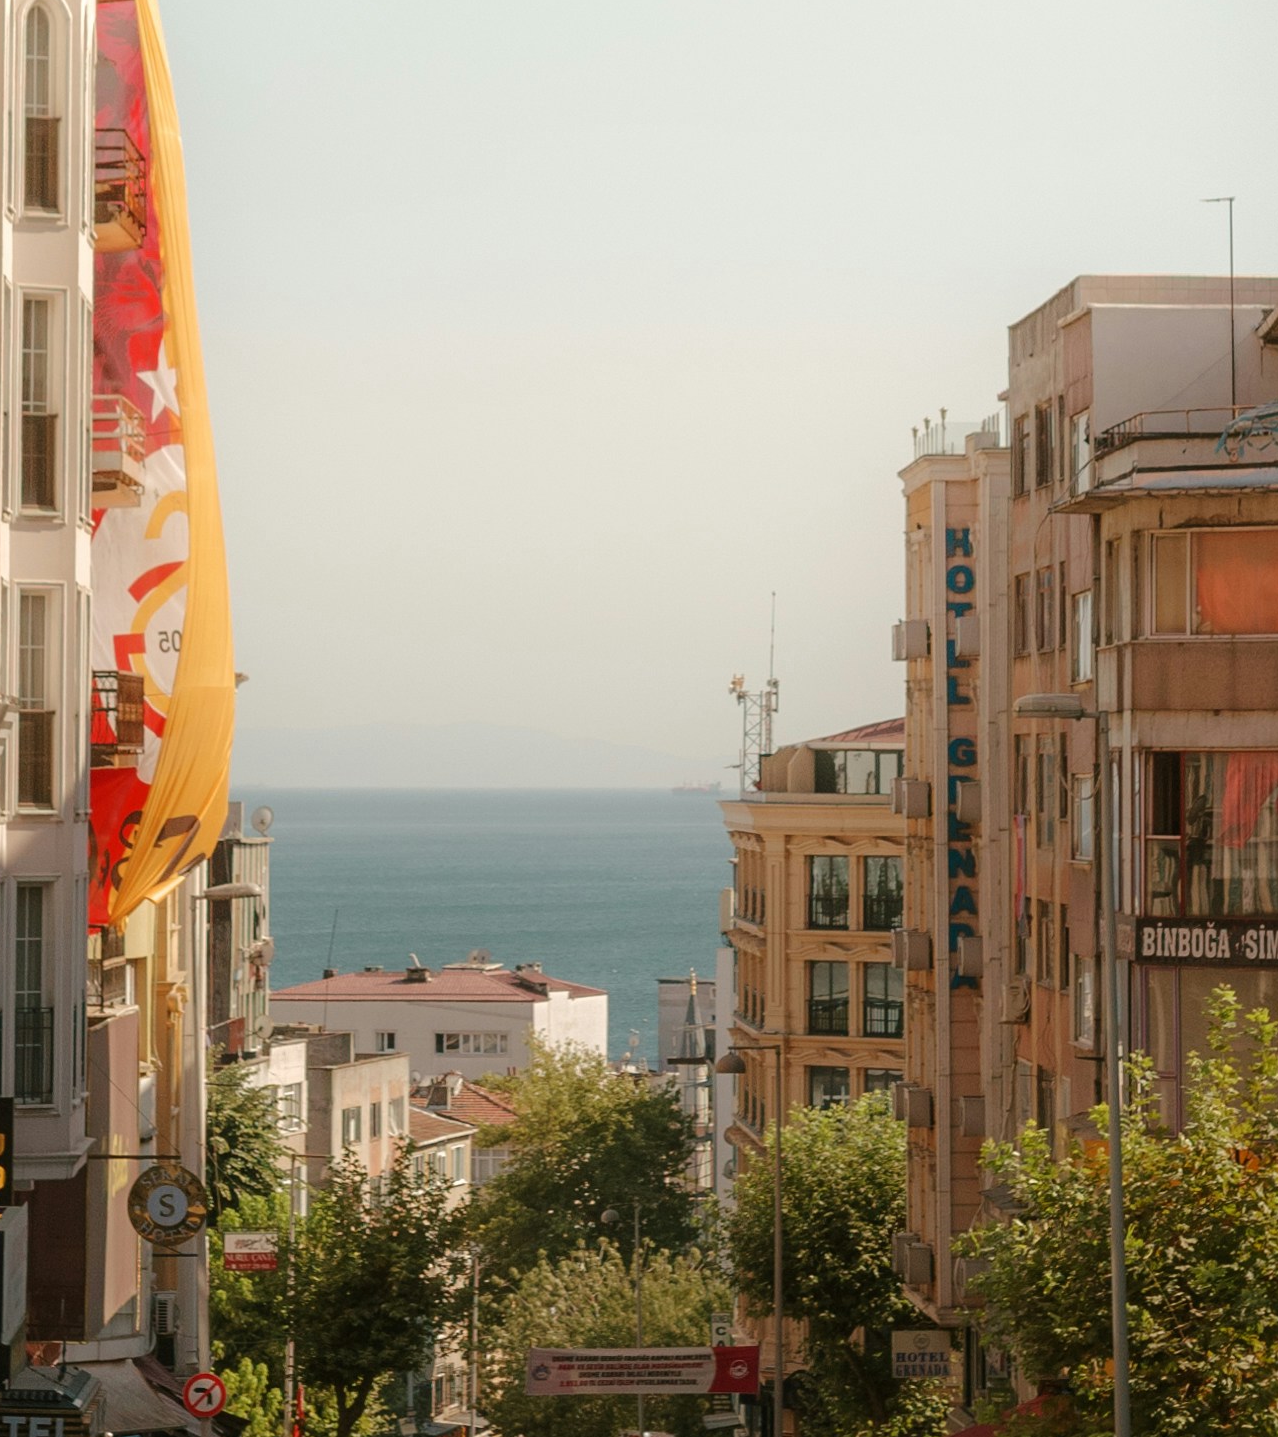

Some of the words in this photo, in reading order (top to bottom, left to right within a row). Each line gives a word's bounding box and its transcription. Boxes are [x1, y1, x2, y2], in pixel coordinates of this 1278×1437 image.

[1142, 921, 1231, 959] BİNBOĞA
[159, 1194, 175, 1217] S
[896, 1352, 949, 1363] HOTEL
